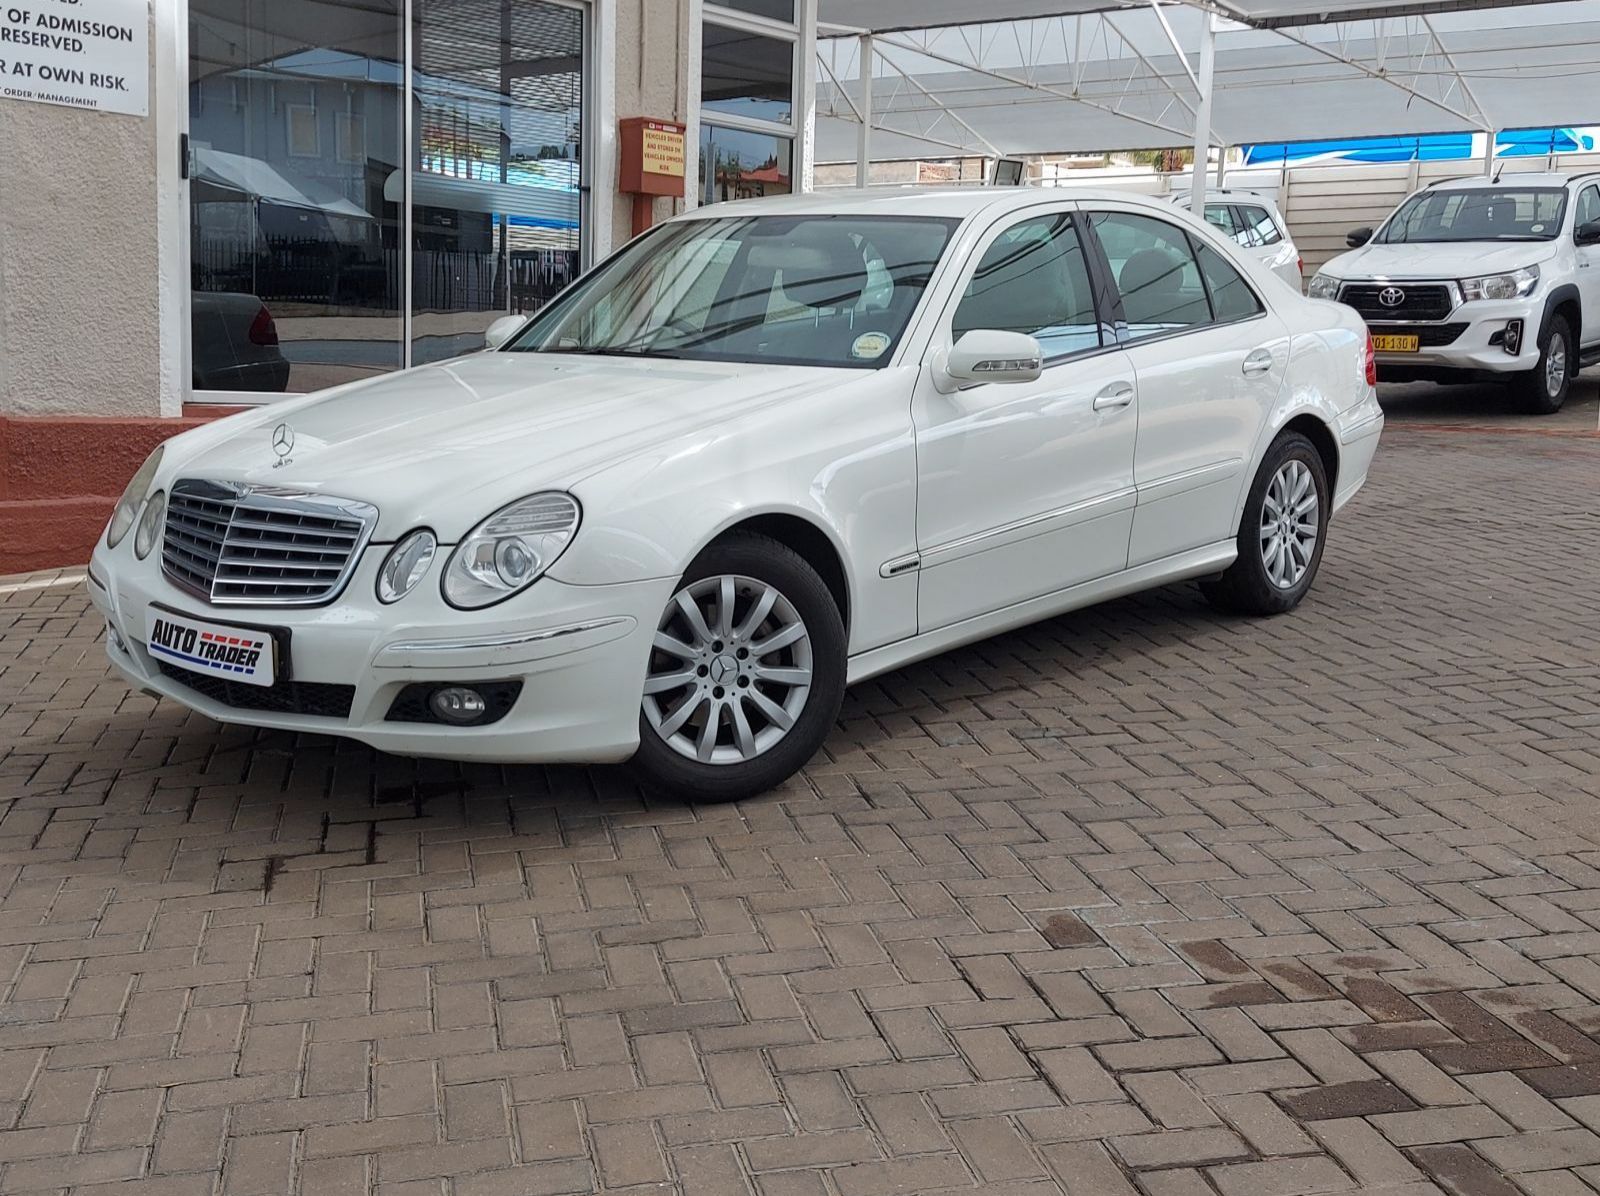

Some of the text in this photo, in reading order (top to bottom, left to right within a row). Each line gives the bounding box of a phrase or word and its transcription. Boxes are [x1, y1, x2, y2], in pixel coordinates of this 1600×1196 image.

[1, 26, 86, 54] RESERVED.
[7, 8, 133, 42] OF ADMISSION
[12, 62, 33, 77] AT
[38, 65, 84, 84] OWN
[90, 73, 129, 92] RISK.
[151, 619, 260, 668] AUTO TRADER
